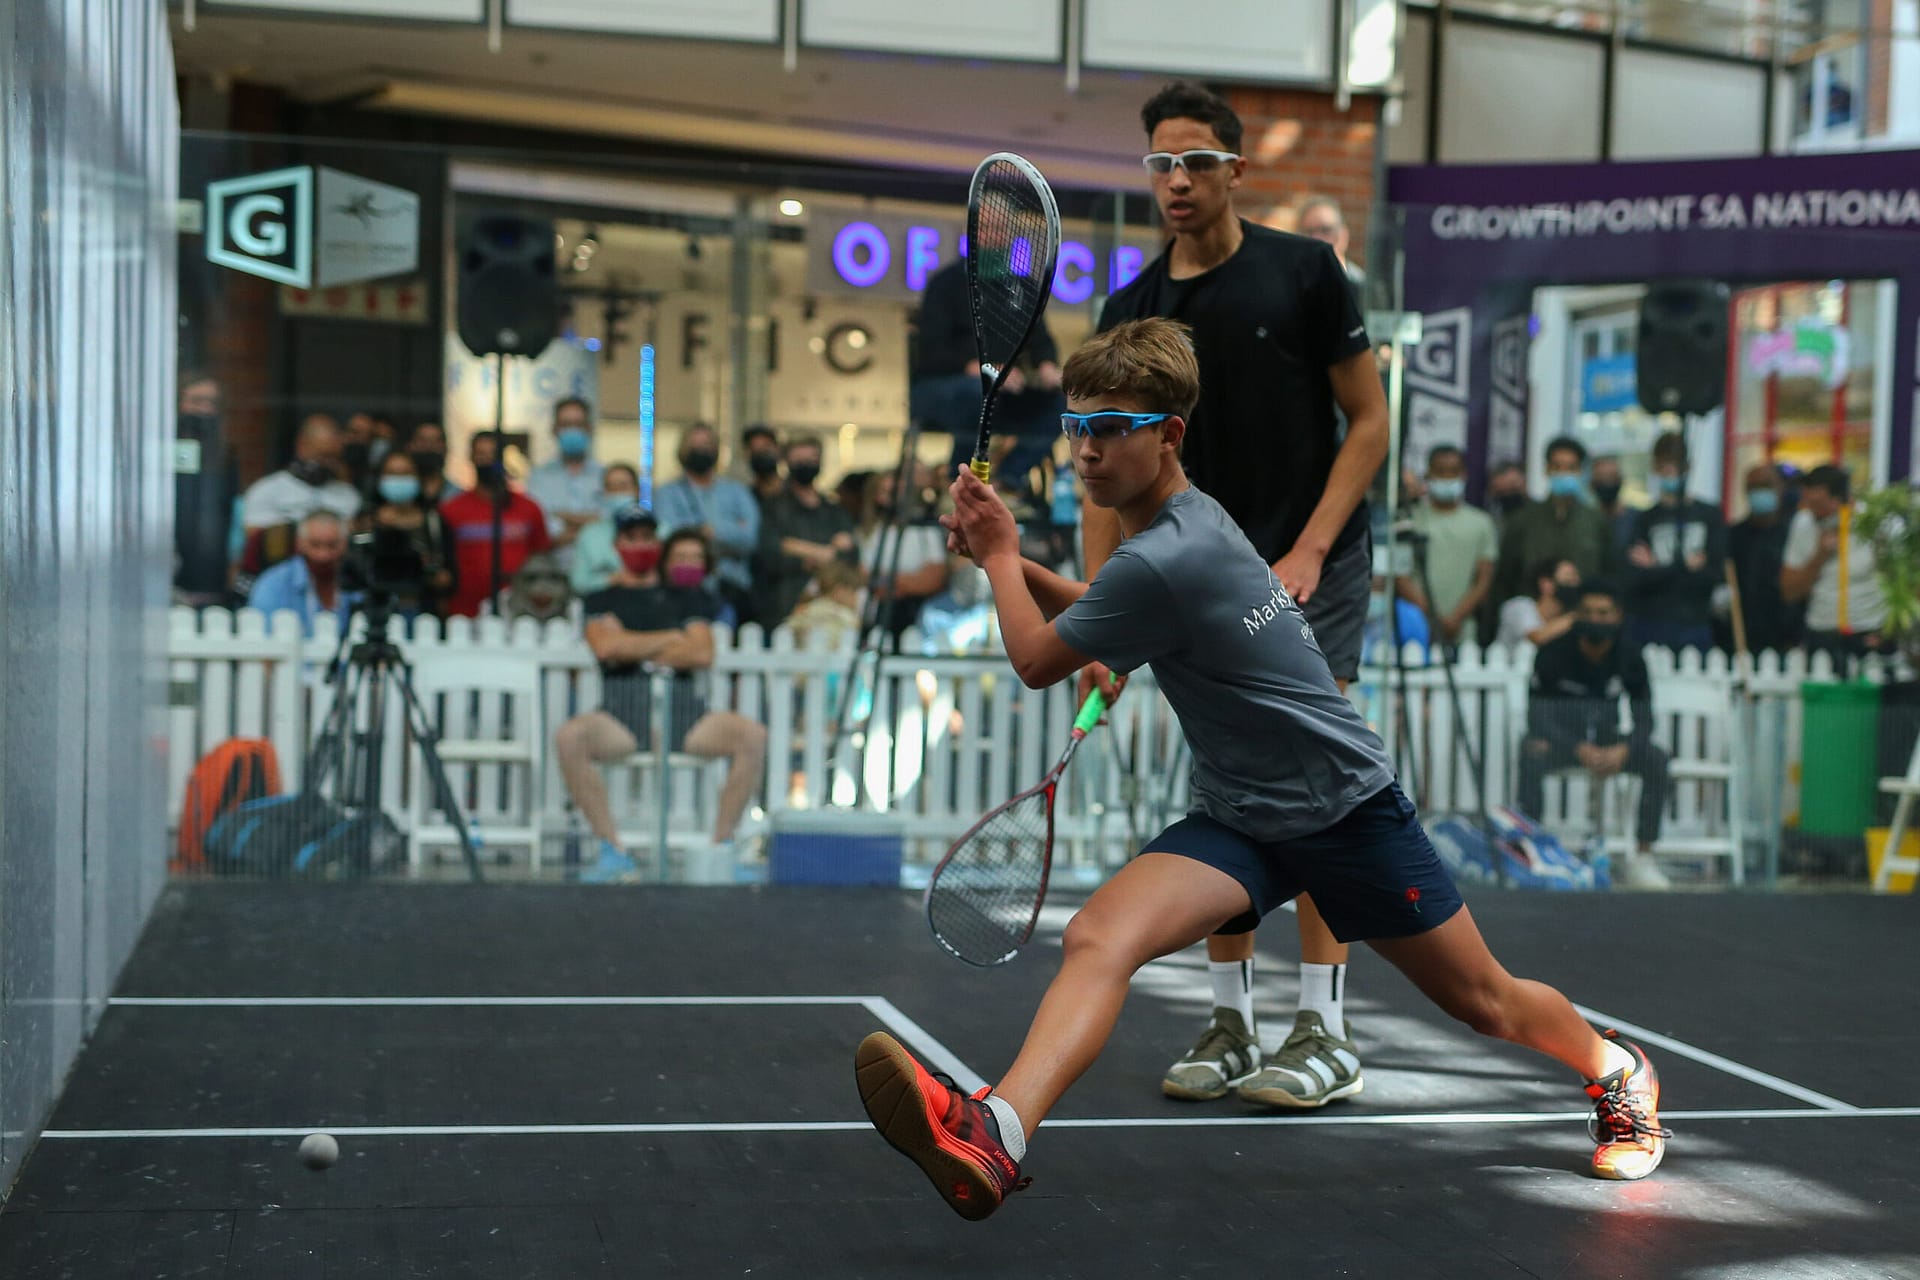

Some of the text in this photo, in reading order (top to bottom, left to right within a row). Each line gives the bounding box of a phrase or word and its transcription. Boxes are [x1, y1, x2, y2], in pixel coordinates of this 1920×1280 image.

[229, 194, 287, 256] G
[1431, 195, 1695, 241] GROWTHPOINT
[1699, 193, 1747, 230] SA
